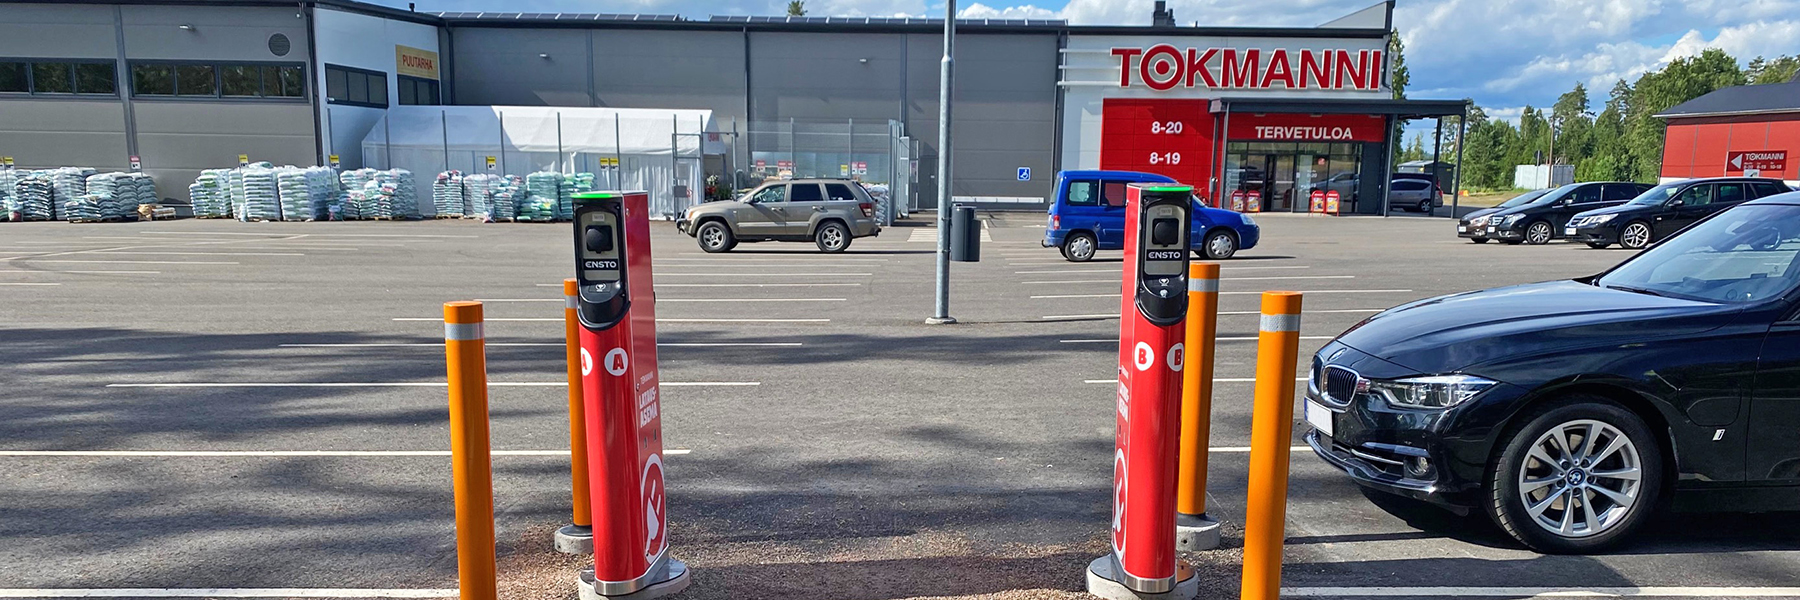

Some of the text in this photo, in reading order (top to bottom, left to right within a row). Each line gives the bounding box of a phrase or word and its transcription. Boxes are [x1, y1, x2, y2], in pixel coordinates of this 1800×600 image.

[402, 54, 433, 70] PUUTARHA
[1111, 43, 1382, 91] TOKMANNI
[1151, 121, 1183, 134] 8-20
[1254, 126, 1353, 140] TERVETULOA
[1149, 151, 1181, 165] 8-19
[1148, 251, 1181, 259] ENSTO
[585, 261, 617, 269] ENSTO
[612, 353, 624, 370] A
[1138, 348, 1147, 364] B
[1174, 349, 1182, 365] B
